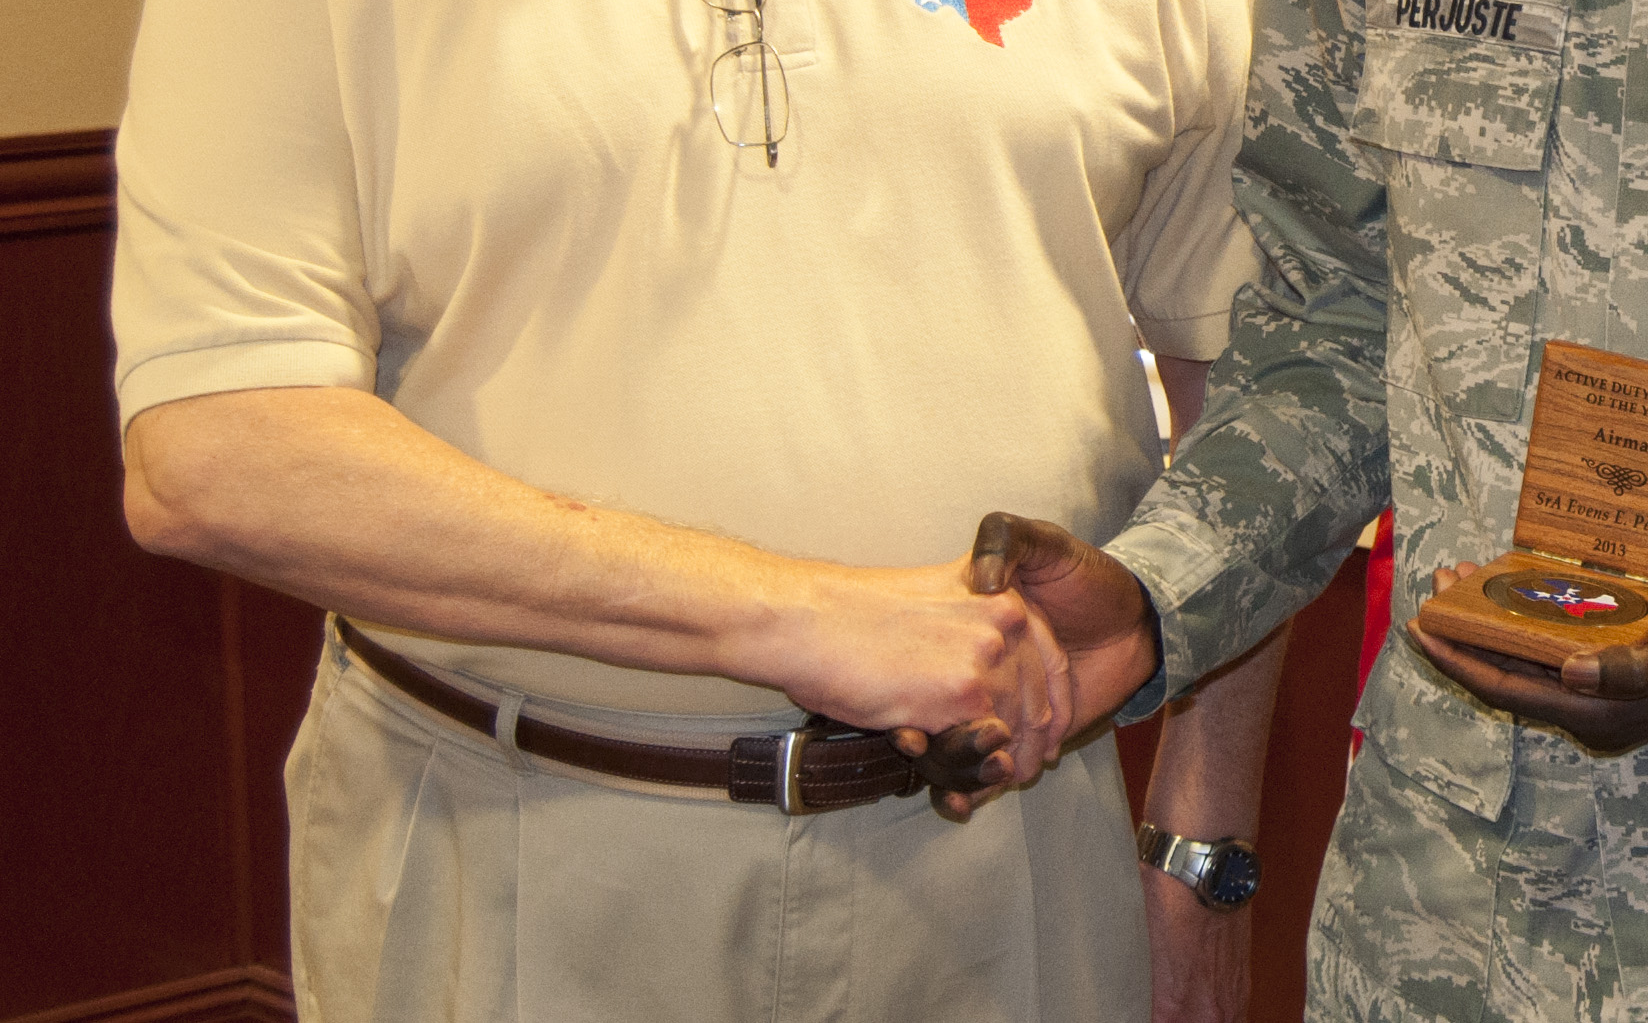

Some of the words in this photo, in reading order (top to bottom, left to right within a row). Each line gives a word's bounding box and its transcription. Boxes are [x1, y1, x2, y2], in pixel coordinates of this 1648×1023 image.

[1555, 369, 1607, 390] ACTIVE
[1586, 392, 1606, 406] OF
[1609, 397, 1638, 414] THE
[1535, 491, 1561, 510] SrA
[1567, 498, 1610, 522] Evens
[1614, 509, 1627, 526] E.
[1593, 538, 1627, 558] 2013
